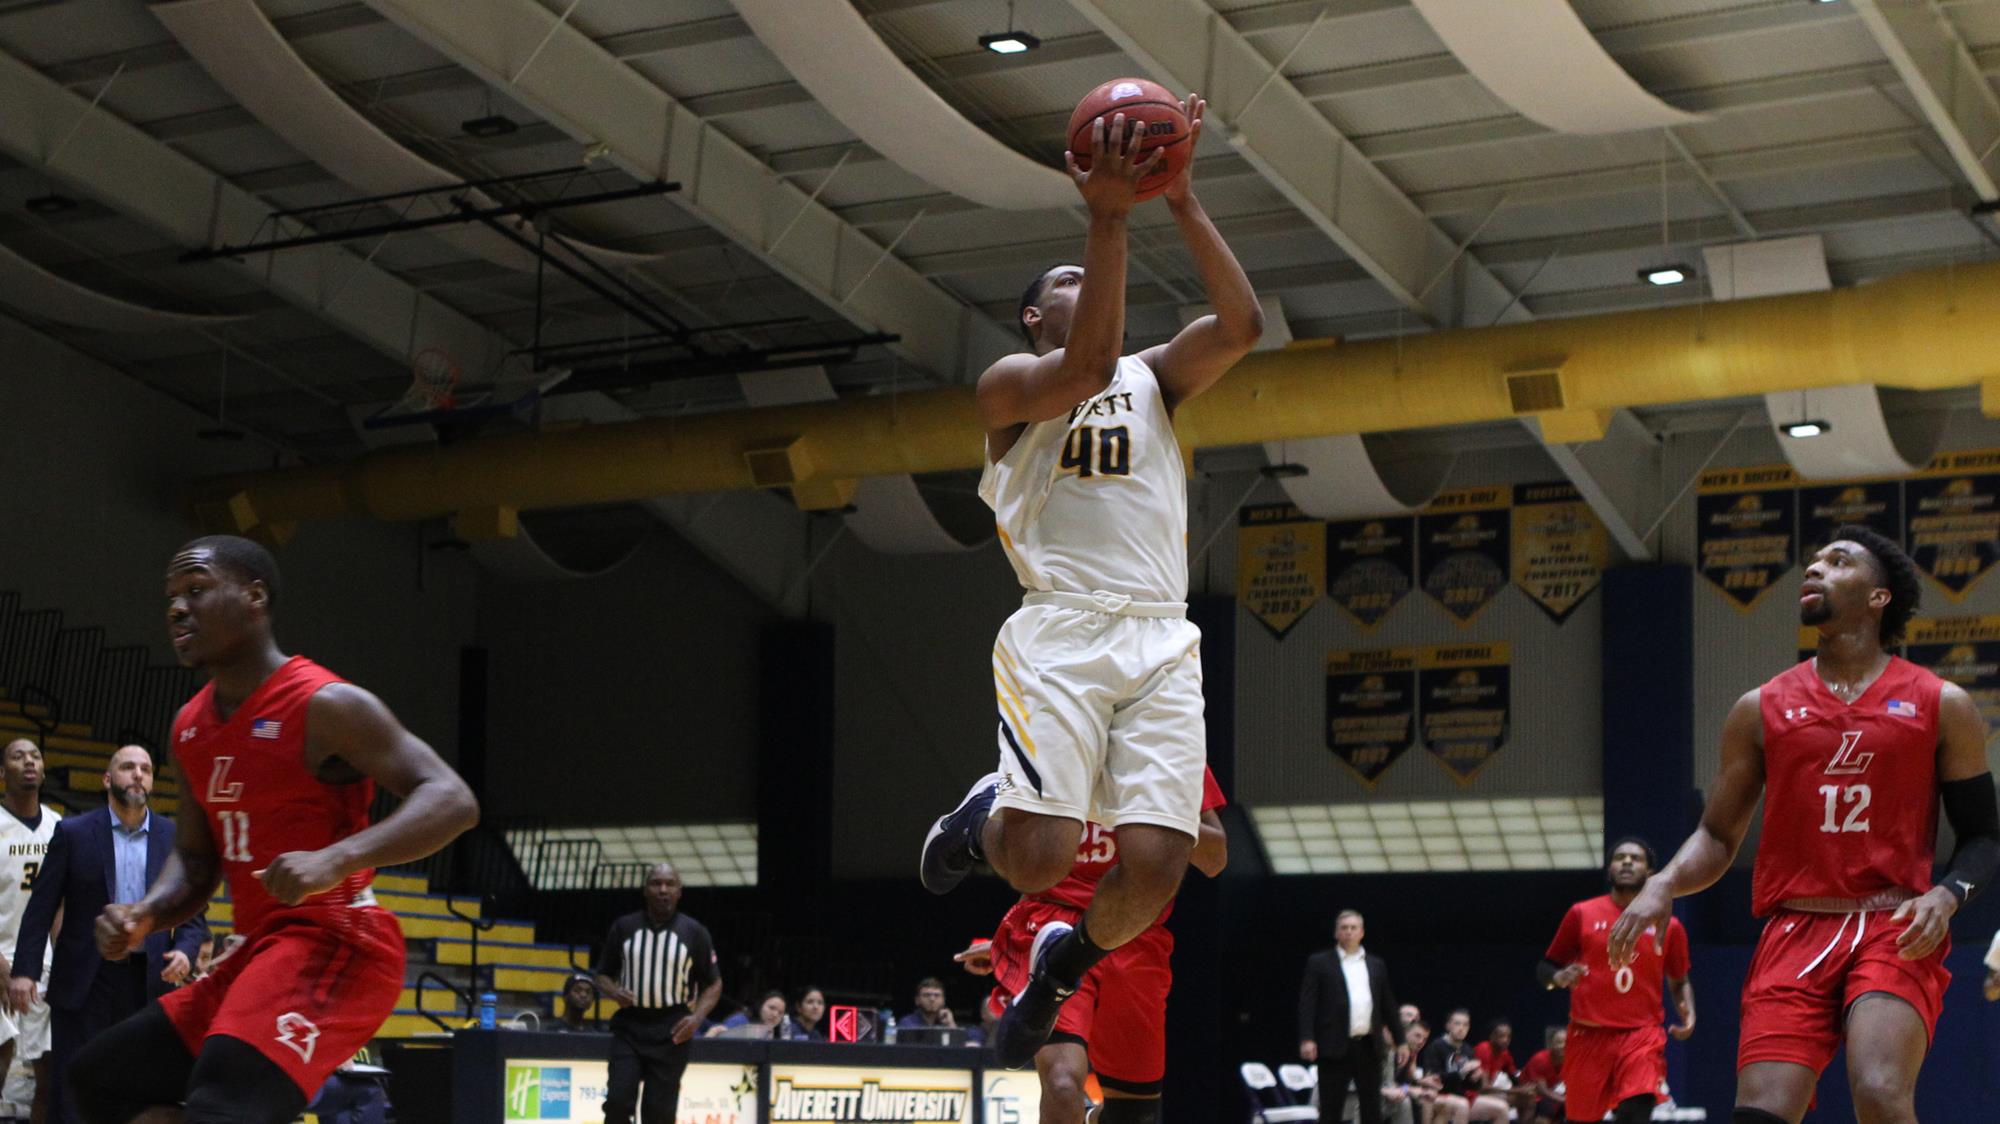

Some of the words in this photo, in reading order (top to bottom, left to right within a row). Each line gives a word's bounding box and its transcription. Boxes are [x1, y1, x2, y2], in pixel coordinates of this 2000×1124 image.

[1061, 426, 1130, 477] 40
[1530, 554, 1589, 565] NATIONAL
[1251, 573, 1308, 587] NATIONAL
[1524, 567, 1597, 581] CHAMPIONS
[1246, 586, 1315, 600] CHAMPIONS
[1542, 582, 1581, 599] 2017
[1436, 647, 1491, 661] FOOTBALL
[1818, 784, 1872, 833] 12
[217, 811, 254, 862] 11
[1615, 966, 1634, 994] 0
[774, 1081, 860, 1121] AVERETT
[860, 1082, 966, 1122] UNIVERSITY
